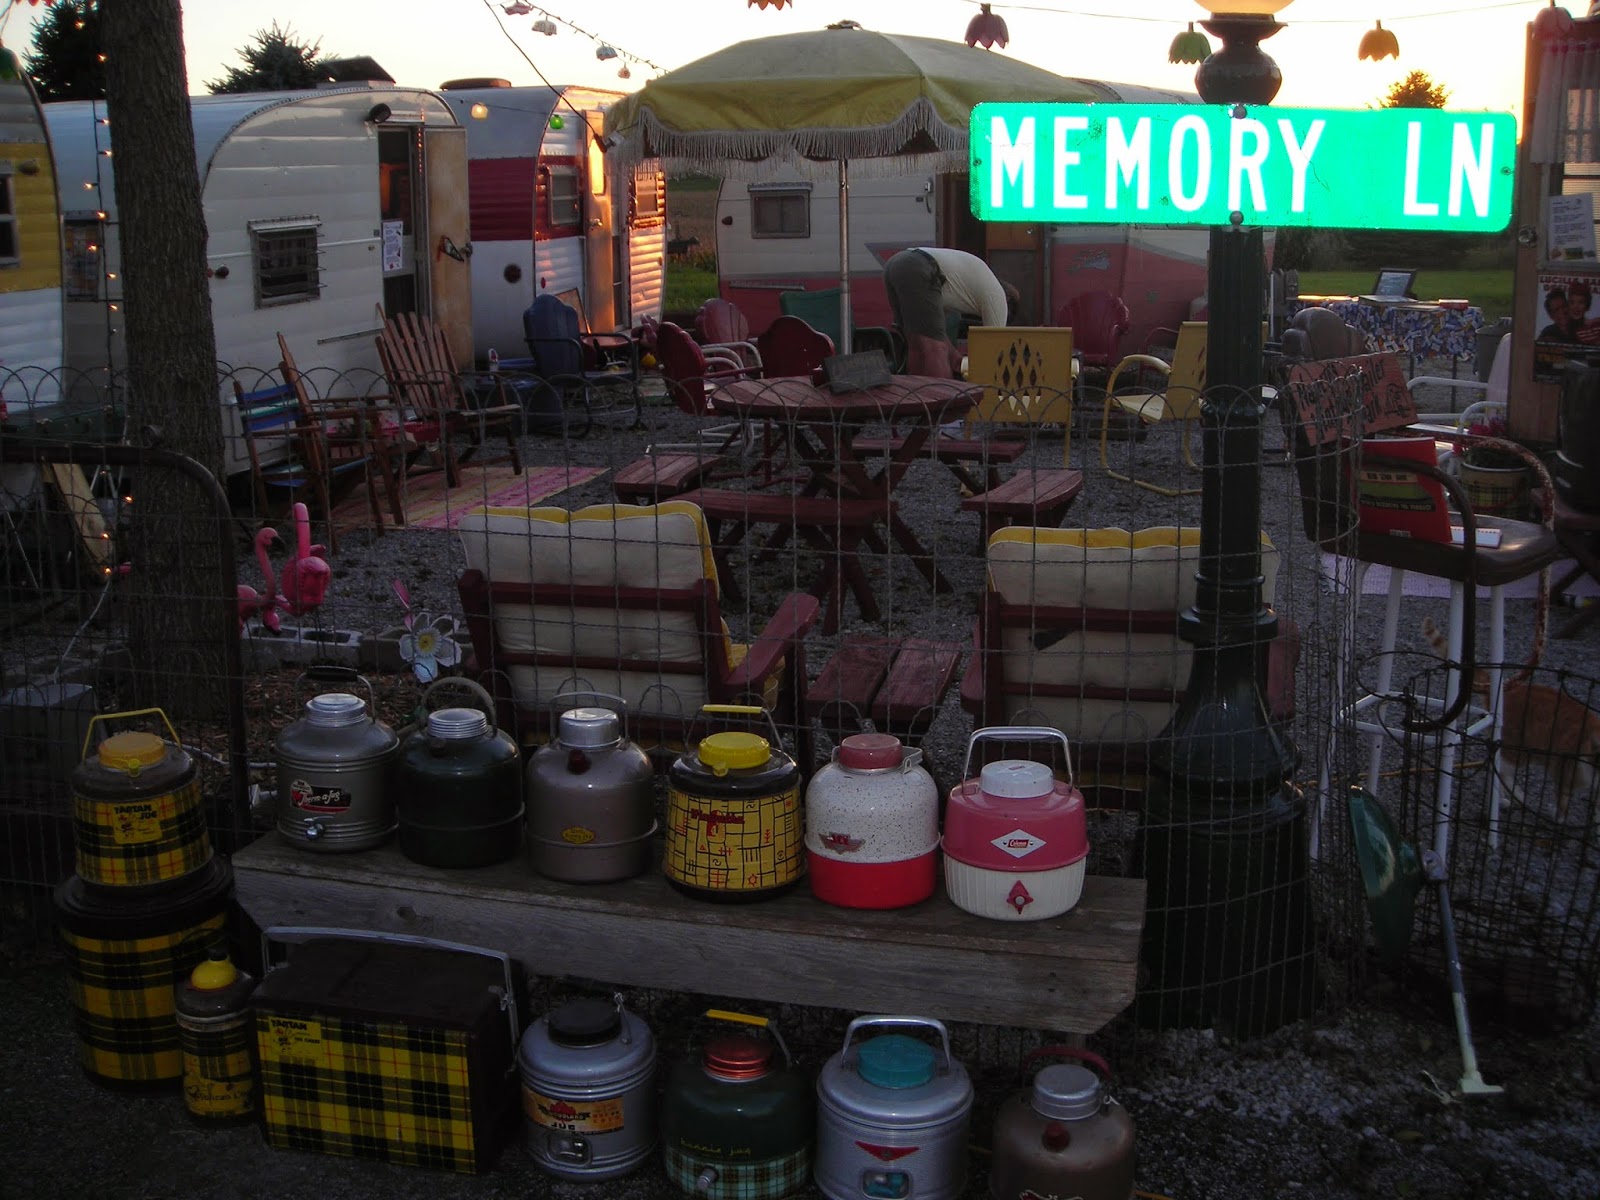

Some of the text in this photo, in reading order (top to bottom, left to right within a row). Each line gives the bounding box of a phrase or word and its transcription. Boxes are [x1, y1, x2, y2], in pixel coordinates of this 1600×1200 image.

[990, 114, 1495, 217] MEMORY LN
[114, 804, 152, 814] TARTAN
